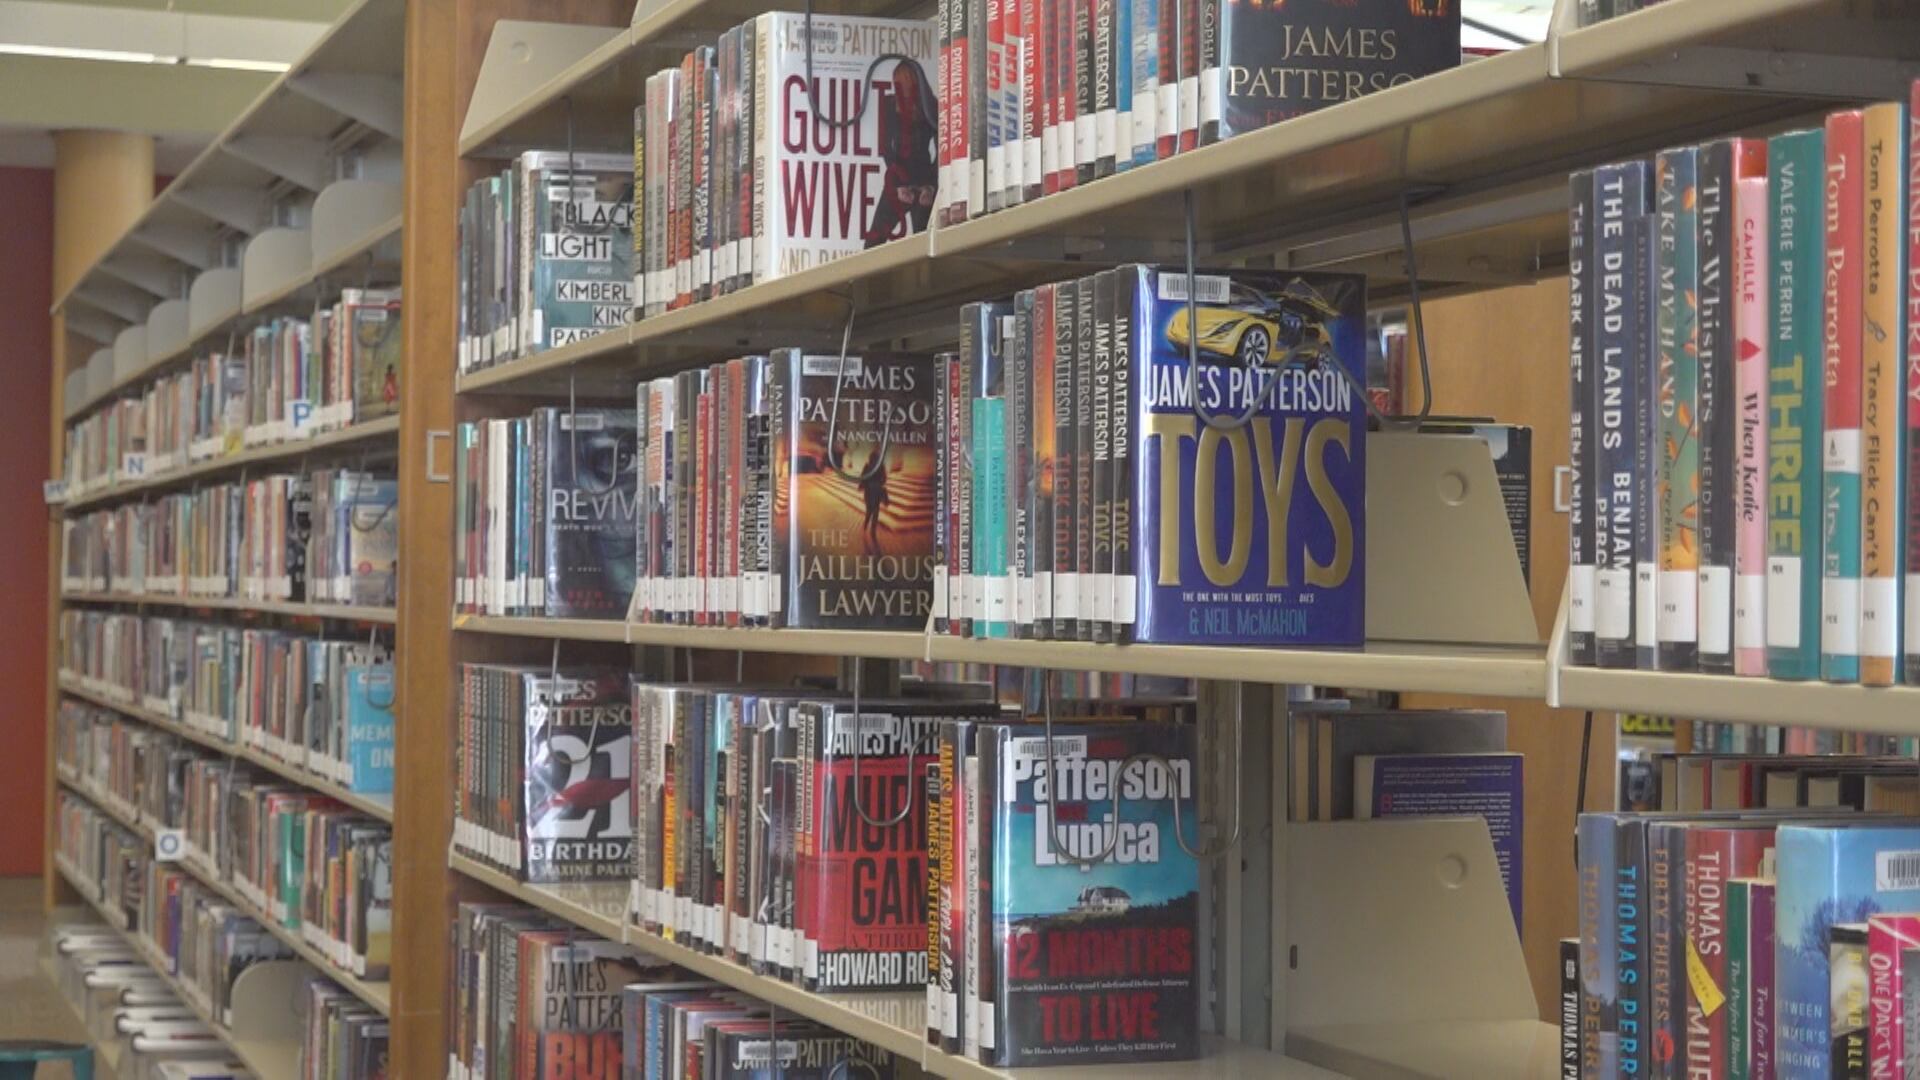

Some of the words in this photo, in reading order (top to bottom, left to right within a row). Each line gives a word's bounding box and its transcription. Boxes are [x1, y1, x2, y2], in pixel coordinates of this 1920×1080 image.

[842, 23, 932, 59] PATTERSON
[1077, 6, 1089, 40] THE
[1281, 24, 1397, 60] JAMES
[951, 48, 963, 97] PRIVATE
[1096, 16, 1110, 109] PATTERSON
[1228, 65, 1416, 101] PATTERS
[951, 103, 962, 147] VEGAS
[1826, 154, 1846, 233] Tom
[1869, 139, 1884, 191] Tom
[699, 155, 711, 237] PATTERSON
[780, 159, 907, 241] WIVE
[1603, 176, 1624, 239] THE
[1660, 167, 1676, 251] TAKE
[1702, 176, 1721, 247] The
[1779, 160, 1795, 251] VALÉRIE
[542, 236, 611, 260] LIGHT
[1570, 202, 1583, 249] THE
[1868, 198, 1882, 296] Perrotta
[1637, 236, 1645, 324] BENJAMIN
[1743, 218, 1755, 303] CAMILLE
[1056, 290, 1073, 340] JAMES
[1079, 288, 1092, 336] JAMES
[1570, 260, 1583, 324] DARK
[1603, 252, 1623, 333] DEAD
[1660, 264, 1676, 315] MY
[1778, 259, 1793, 341] PERRIN
[1825, 246, 1845, 388] Perrotta
[1015, 309, 1026, 357] JAMES
[1095, 319, 1110, 371] JAMES
[1114, 314, 1128, 367] JAMES
[1570, 337, 1582, 384] NET
[1637, 334, 1645, 385] PERCY
[1700, 255, 1721, 422] Whispers
[844, 365, 916, 391] AMES
[1055, 344, 1072, 428] PATTERSON
[1078, 340, 1091, 426] PATTERSON
[1144, 364, 1222, 409] JAMES
[1229, 366, 1351, 413] PATTERSON
[1602, 347, 1622, 450] LANDS
[1660, 328, 1676, 418] HAND
[1866, 362, 1882, 428] Tracy
[293, 403, 311, 428] P
[936, 387, 945, 443] JAMES
[950, 393, 961, 439] JAMES
[1015, 359, 1026, 445] PATTERSON
[1094, 376, 1110, 461] PATTERSON
[1113, 371, 1128, 458] PATTERSON
[1742, 391, 1760, 458] When
[836, 431, 884, 443] NANCY
[888, 431, 927, 444] ALLEN
[1639, 398, 1647, 470] SUICIDE
[1769, 354, 1804, 555] THREE
[1866, 434, 1880, 491] Flick
[128, 456, 144, 474] N
[950, 441, 960, 514] PATTERSON
[1570, 411, 1583, 525] BENJAMIN
[1702, 446, 1713, 514] HEIDI
[936, 449, 944, 545] PATTERSON
[961, 480, 970, 545] SUMMER
[1145, 412, 1354, 589] TOYS
[1638, 479, 1647, 543] WOODS
[1742, 465, 1760, 523] Katie
[1825, 485, 1841, 542] Mrs.
[756, 490, 770, 568] PATTERSON
[808, 528, 850, 547] THE
[1015, 508, 1026, 543] ALEX
[1094, 499, 1110, 553] TOYS
[1114, 499, 1130, 552] TOYS
[1865, 497, 1879, 561] Can't
[818, 589, 932, 617] LAWYER
[1182, 592, 1194, 602] THE
[1197, 592, 1210, 602] ONE
[1212, 592, 1229, 602] WITH
[1231, 592, 1244, 603] THE
[1266, 593, 1283, 603] TOYS
[1189, 608, 1200, 634] &
[1203, 608, 1233, 635] NEIL
[940, 739, 953, 791] JAMES
[1004, 754, 1191, 801] Patterson
[737, 809, 748, 898] PATTERSON
[928, 800, 940, 862] JAMES
[939, 795, 953, 883] PATTERSON
[1035, 803, 1160, 872] Lupica
[1654, 848, 1670, 917] FORTY
[1696, 850, 1721, 956] THOMAS
[928, 867, 940, 972] PATTERSON
[1617, 865, 1637, 985] THOMAS
[826, 953, 900, 986] HOWARD
[1047, 925, 1193, 978] MONTHS
[1654, 930, 1672, 1022] THIEVES
[1731, 959, 1741, 982] The
[1869, 953, 1893, 996] ONE
[545, 996, 624, 1029] PATTER
[1039, 994, 1082, 1044] TO
[1090, 992, 1160, 1041] LIVE
[1563, 992, 1579, 1062] THOMAS
[1728, 986, 1741, 1033] Perfect
[1756, 986, 1769, 1017] Tea
[1871, 997, 1893, 1050] PART
[796, 1037, 890, 1069] PATTERSON
[1753, 1018, 1769, 1047] for
[1847, 1035, 1864, 1070] ALL
